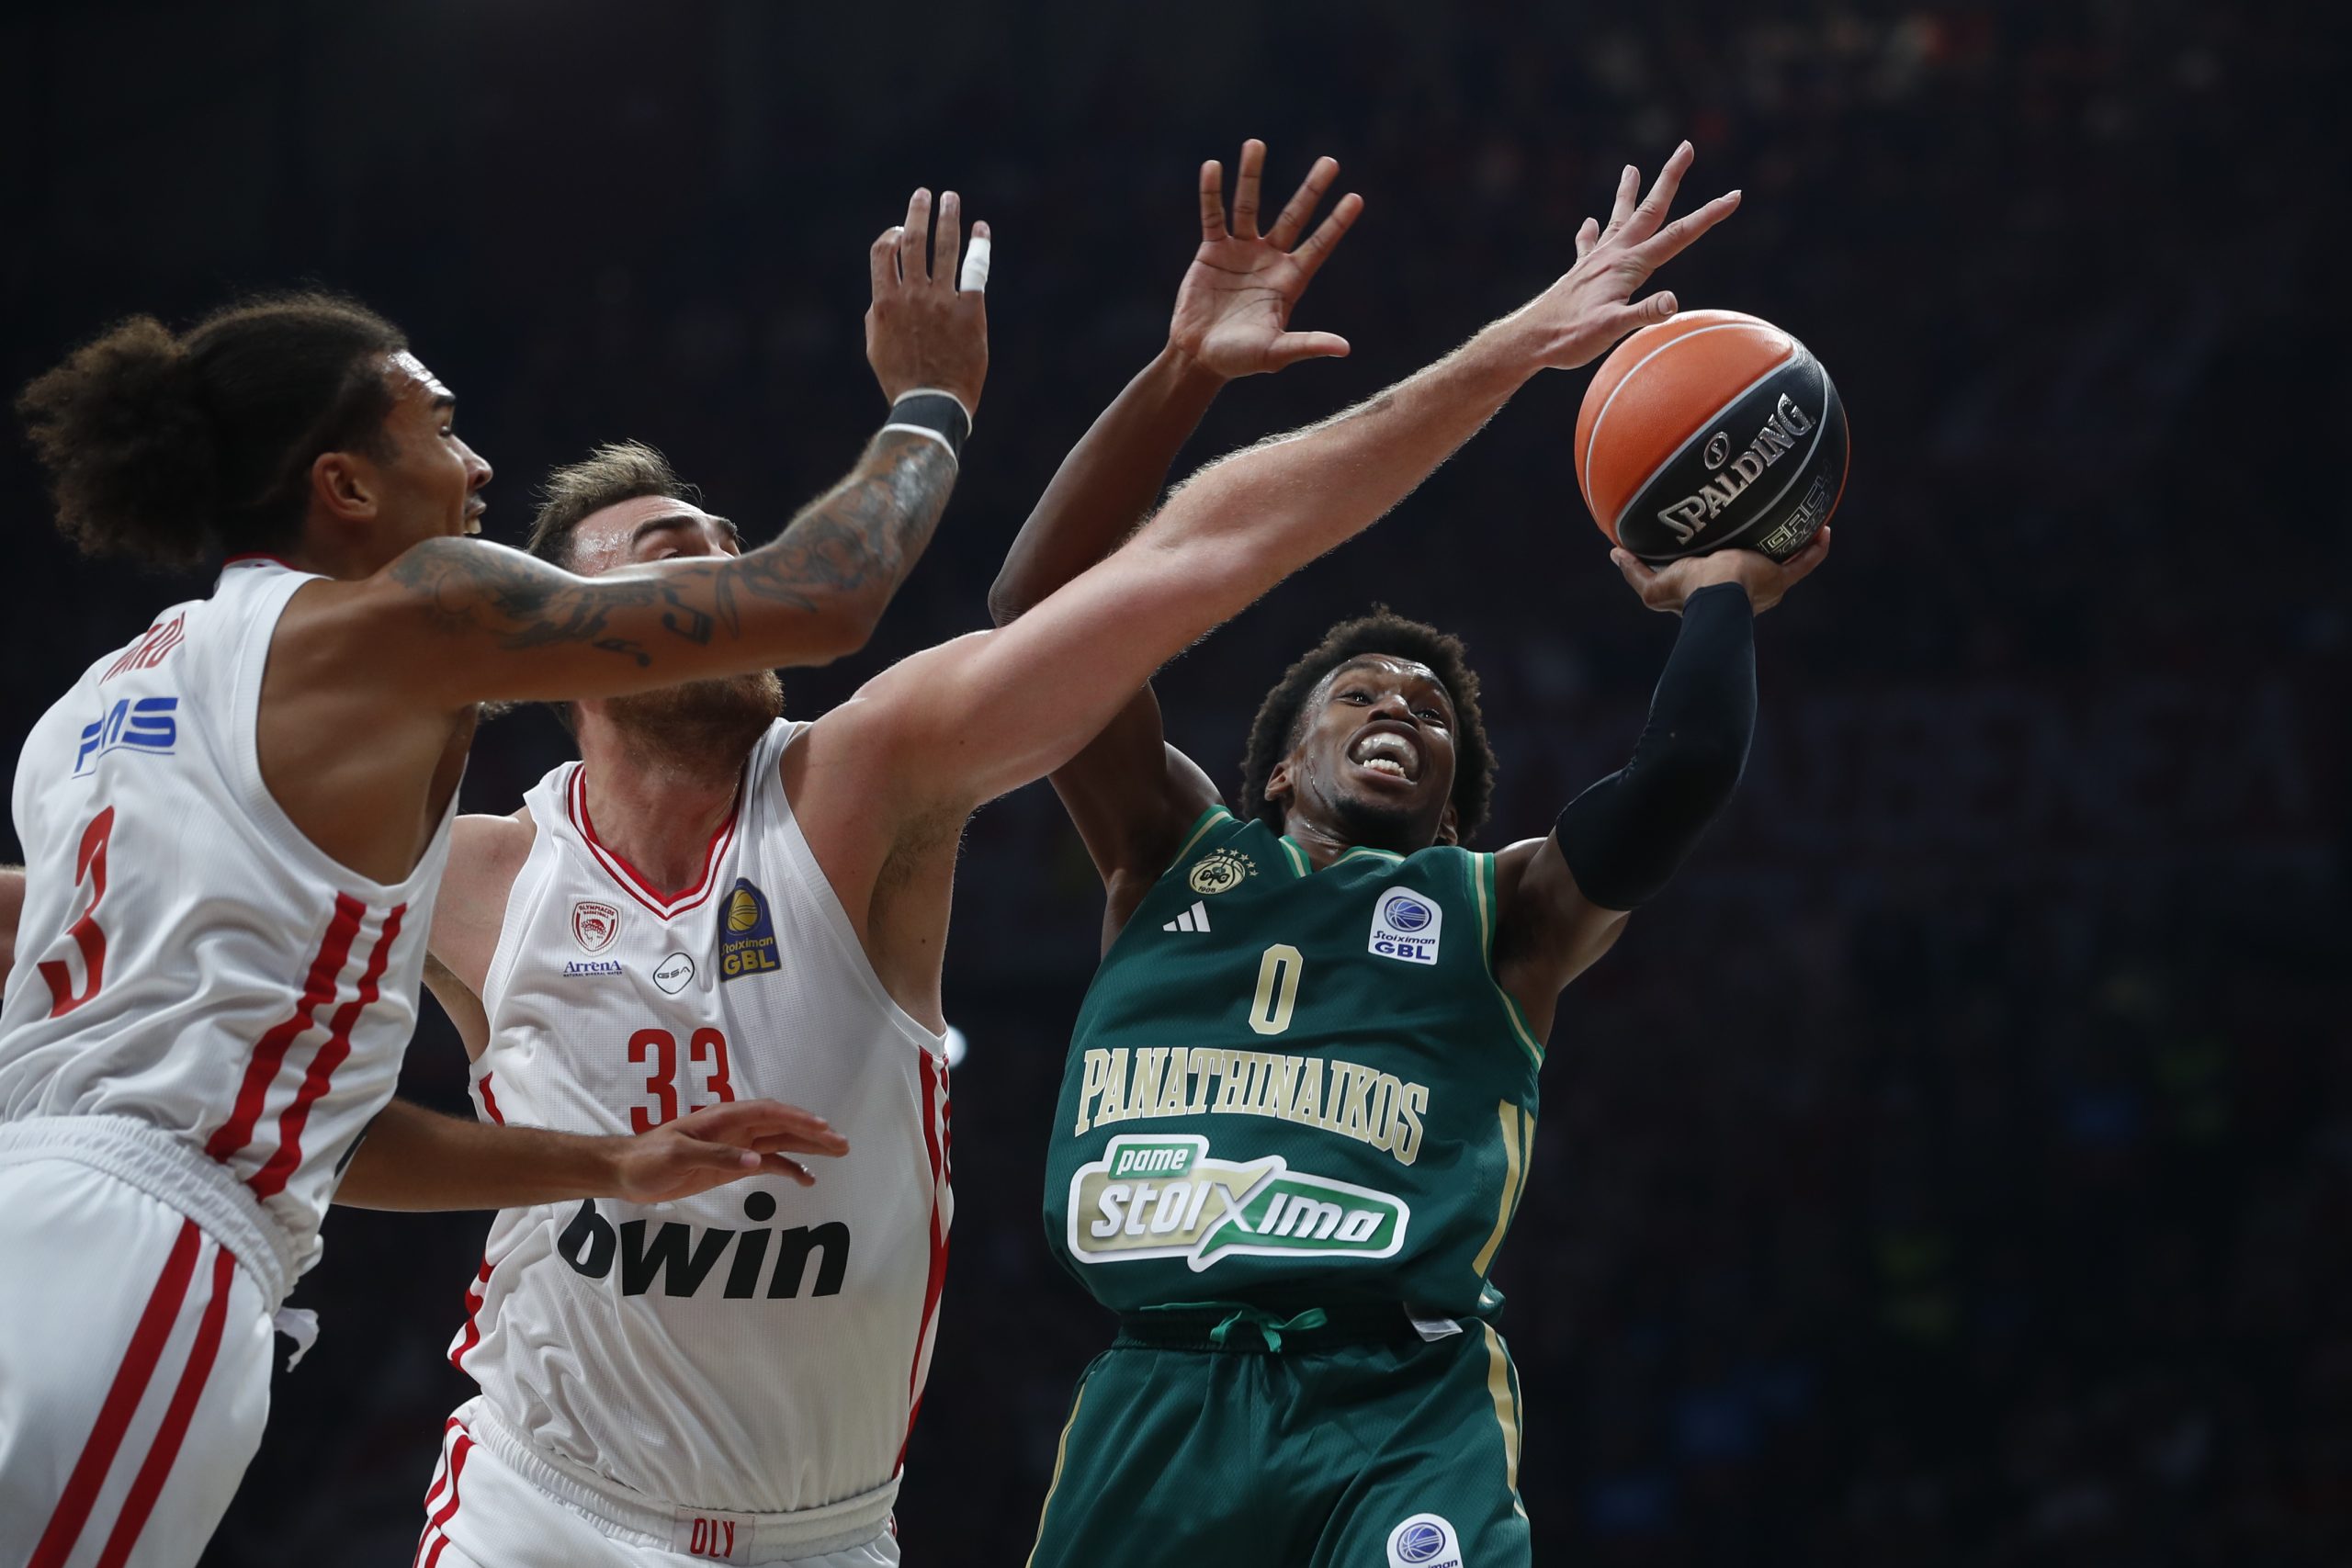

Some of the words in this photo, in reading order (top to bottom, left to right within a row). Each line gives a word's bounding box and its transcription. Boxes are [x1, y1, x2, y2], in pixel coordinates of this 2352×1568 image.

[1657, 392, 1813, 546] SPALDING
[37, 805, 115, 1020] 3
[1373, 931, 1436, 945] Stoiximan
[1374, 941, 1431, 961] GBL
[723, 950, 775, 976] GBL
[1249, 943, 1304, 1035] 0
[628, 1027, 736, 1135] 33
[1075, 1047, 1430, 1167] PANATHINAIKOS
[1115, 1147, 1189, 1176] pame
[558, 1190, 850, 1300] bwin
[690, 1517, 735, 1558] OLY
